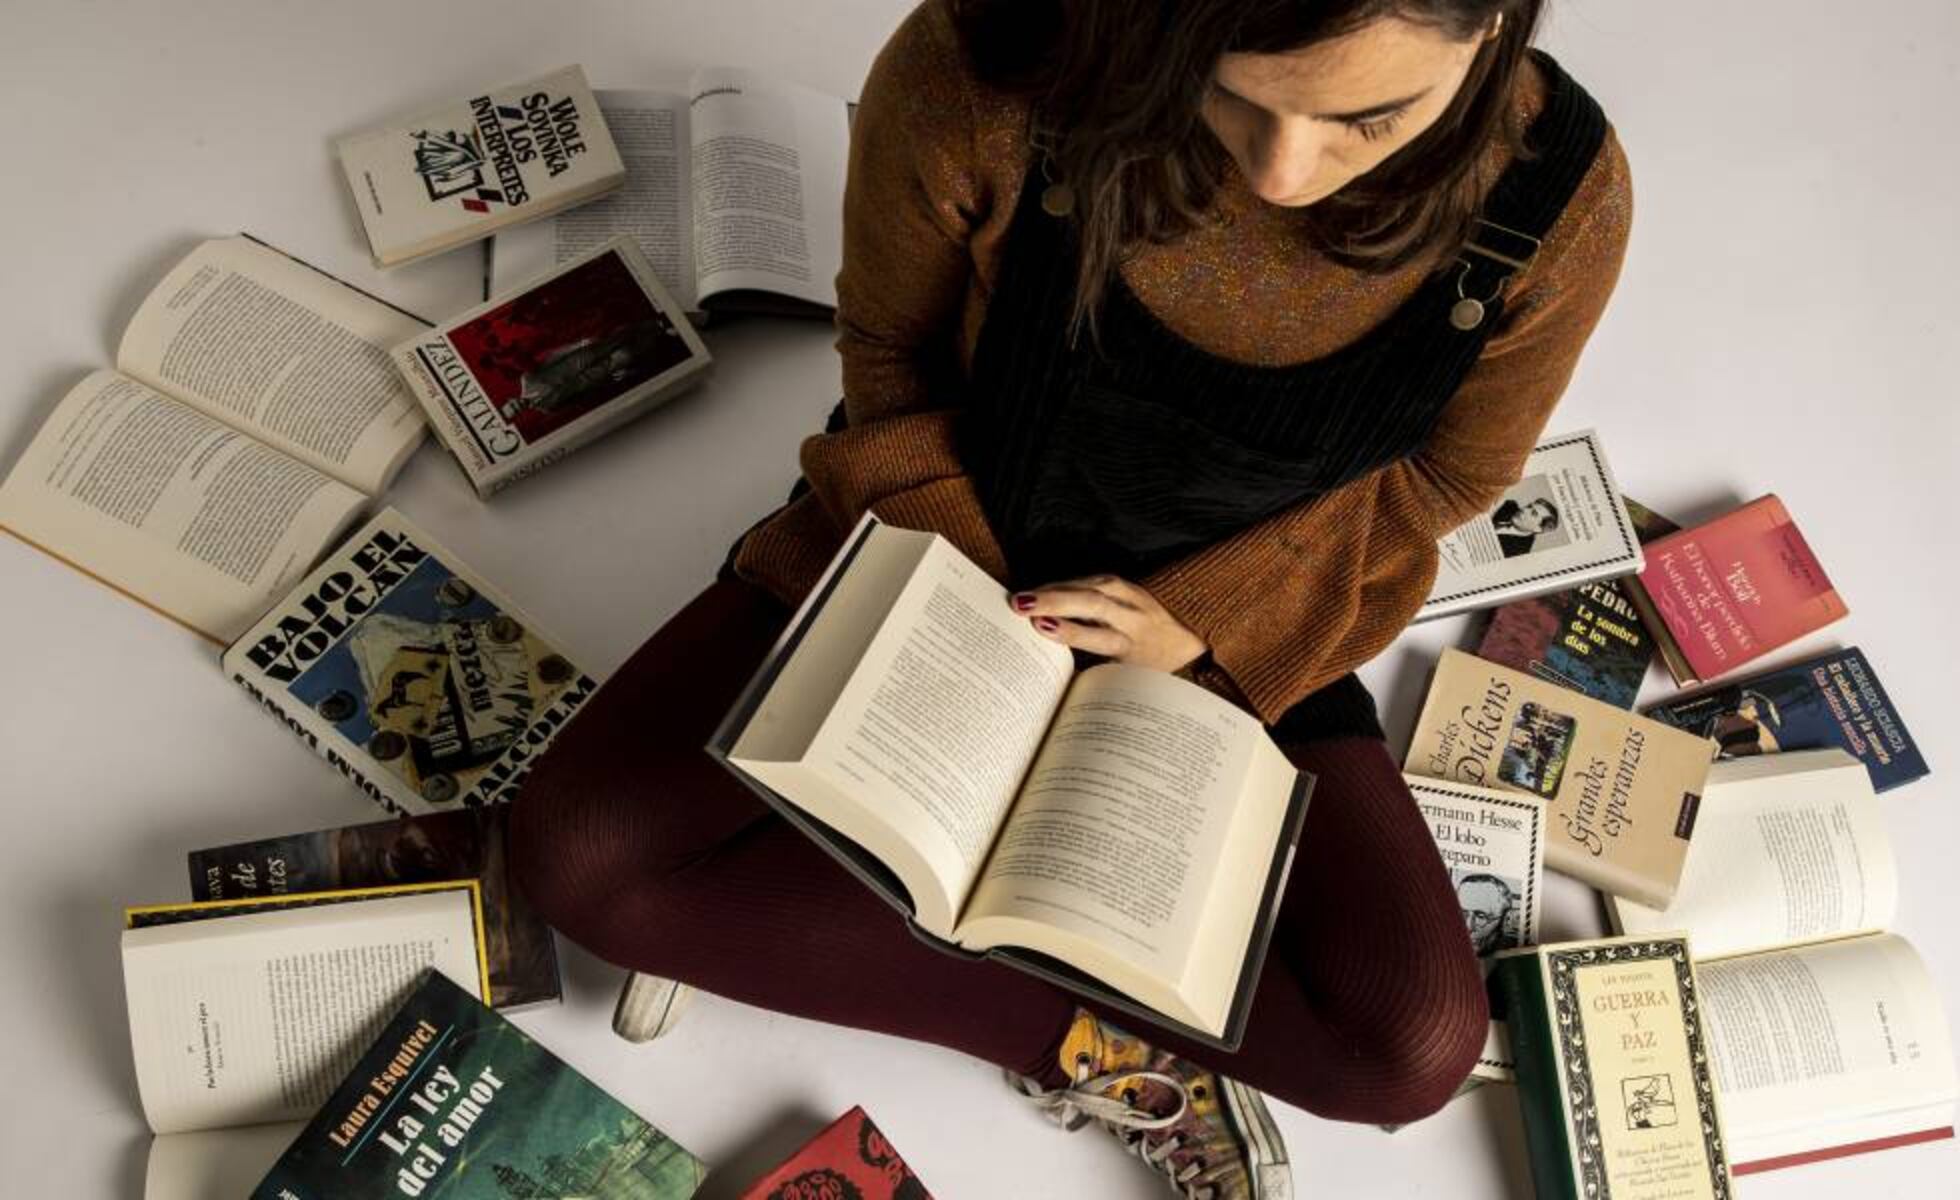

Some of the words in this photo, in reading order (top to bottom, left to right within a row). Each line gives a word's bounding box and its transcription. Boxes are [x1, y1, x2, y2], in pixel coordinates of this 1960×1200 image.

[470, 95, 529, 206] INTERPRETES
[506, 125, 537, 163] LOS
[521, 92, 570, 177] SOYINKA
[547, 96, 586, 157] WOLE
[246, 572, 354, 669] BAJO
[350, 530, 408, 573] EL
[1577, 604, 1594, 622] La
[1571, 619, 1587, 635] de
[1589, 628, 1608, 646] los
[1430, 721, 1461, 776] Charles
[1455, 677, 1512, 788] Dickens
[1559, 756, 1609, 857] Grandes
[1602, 727, 1646, 838] esperanzas
[1436, 824, 1450, 841] El
[1455, 827, 1486, 847] lobo
[1479, 809, 1522, 831] Hesse
[207, 867, 222, 898] ava
[231, 863, 256, 888] de
[1593, 990, 1670, 1012] GUERRA
[1630, 1013, 1641, 1029] Y
[1621, 1031, 1658, 1050] PAZ
[329, 1094, 381, 1148] Laura
[371, 1020, 438, 1096] Esquivel
[378, 1115, 425, 1156] La
[410, 1065, 460, 1115] ley
[397, 1143, 446, 1197] del
[438, 1065, 504, 1147] amor
